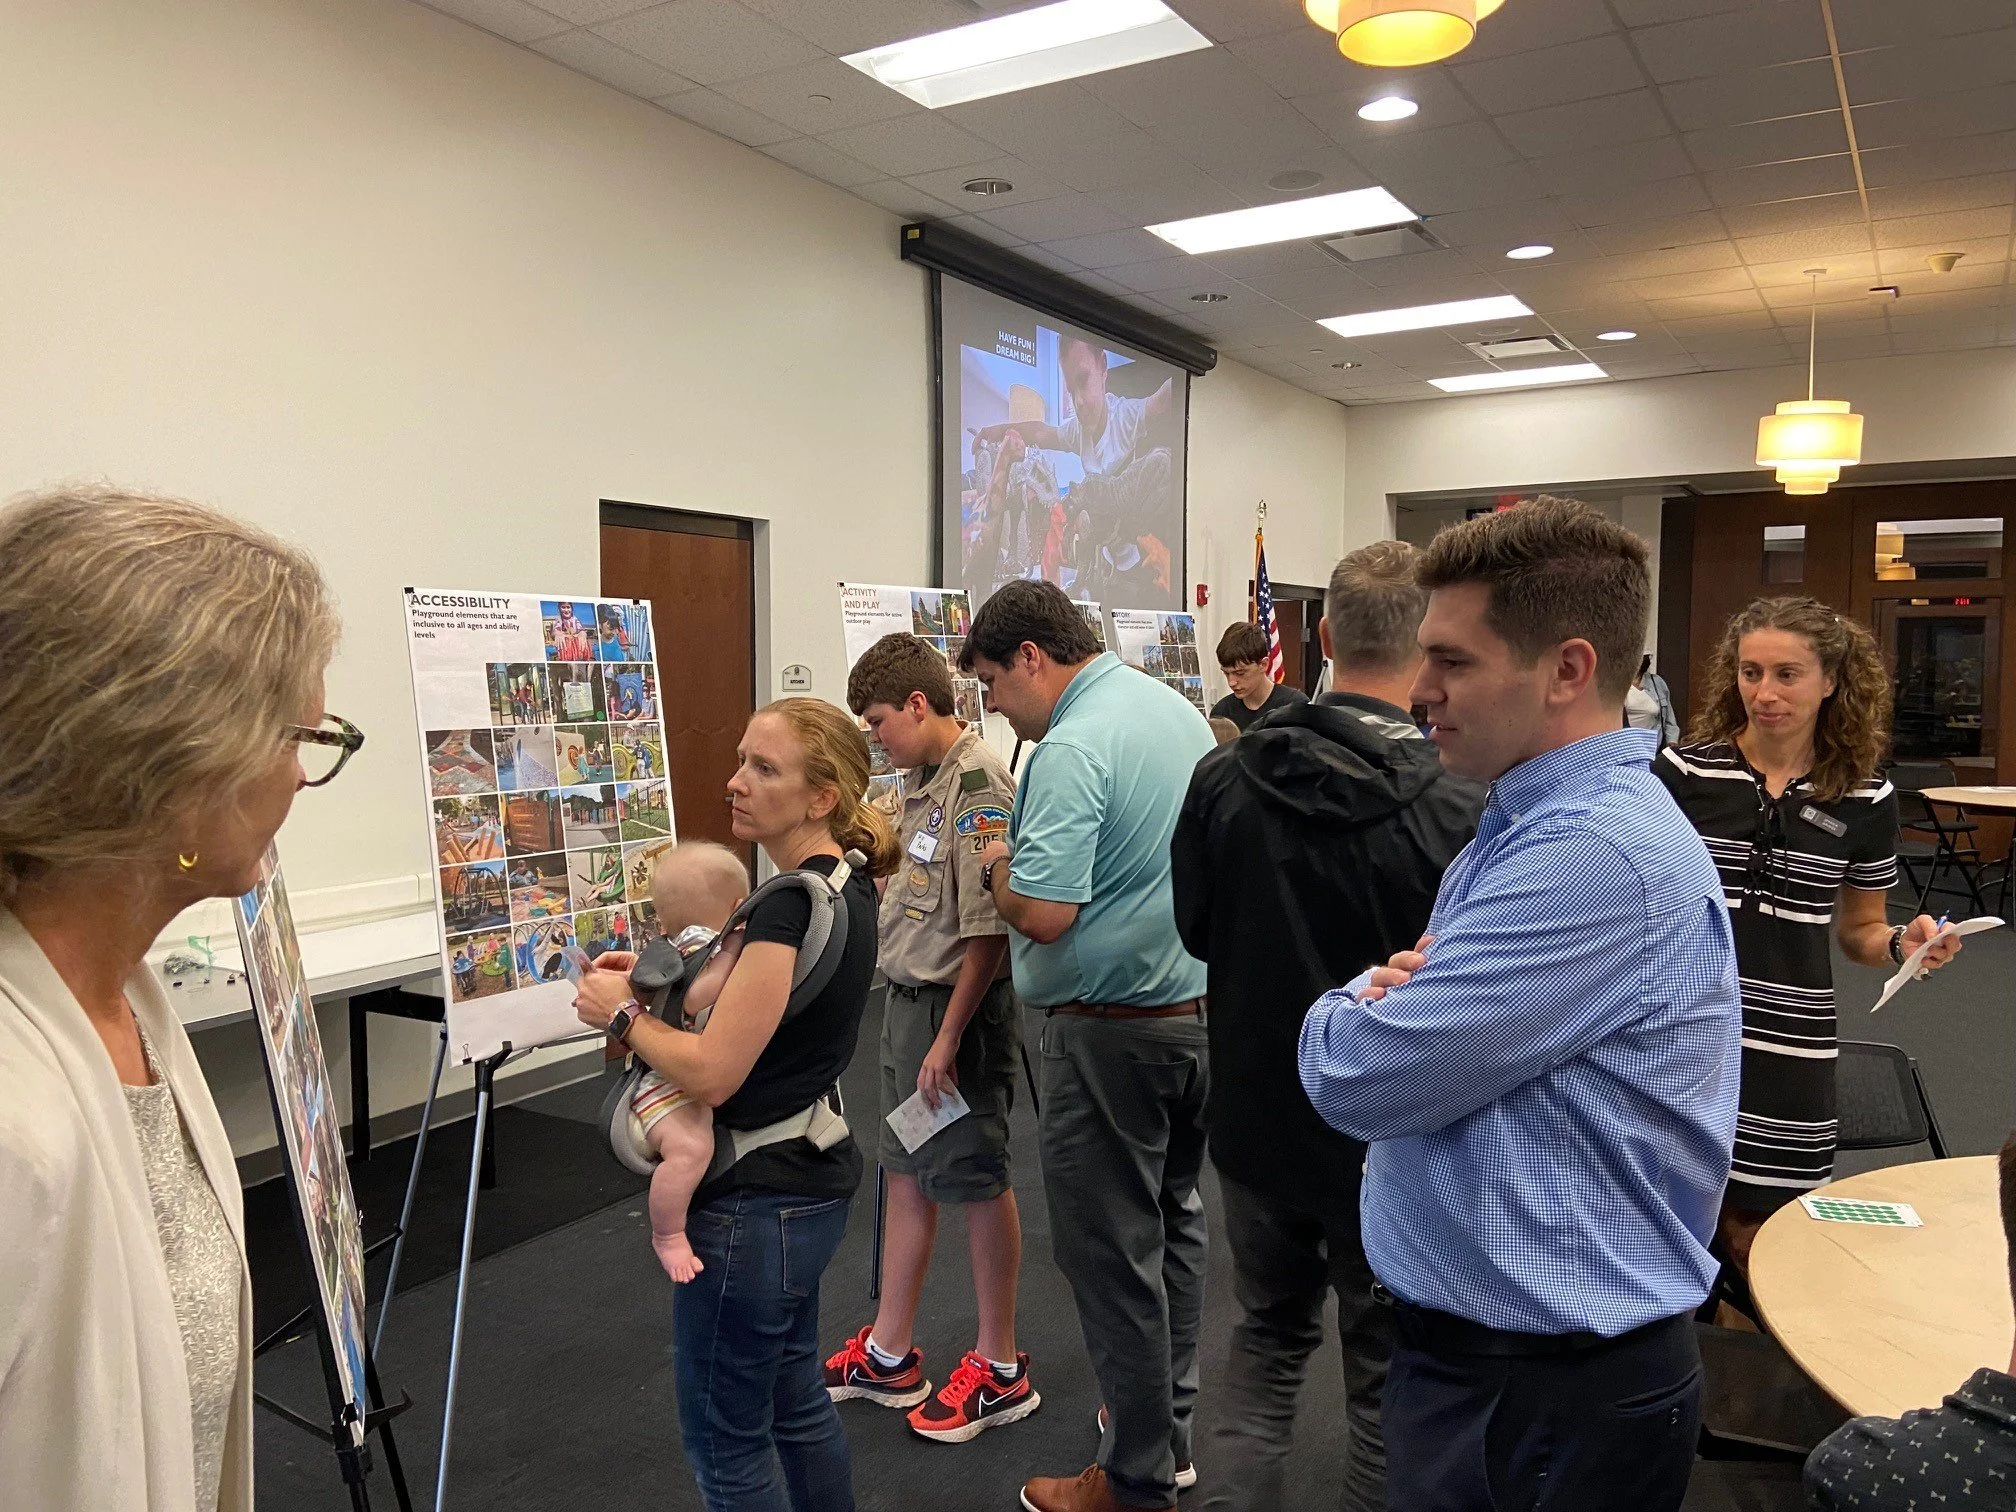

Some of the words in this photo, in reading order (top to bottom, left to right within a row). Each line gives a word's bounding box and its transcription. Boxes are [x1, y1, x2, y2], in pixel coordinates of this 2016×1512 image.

[998, 331, 1017, 344] HAVE
[996, 344, 1019, 360] DREAM
[843, 588, 877, 597] ACTIVITY
[411, 594, 510, 609] ACCESSIBILITY
[844, 600, 861, 609] AND
[862, 601, 880, 609] PLAY
[412, 609, 454, 619] Playground
[455, 612, 489, 620] elements
[490, 612, 504, 620] that
[413, 620, 445, 629] inclusive
[467, 623, 483, 631] ages
[499, 623, 520, 632] ability
[414, 631, 436, 639] levels
